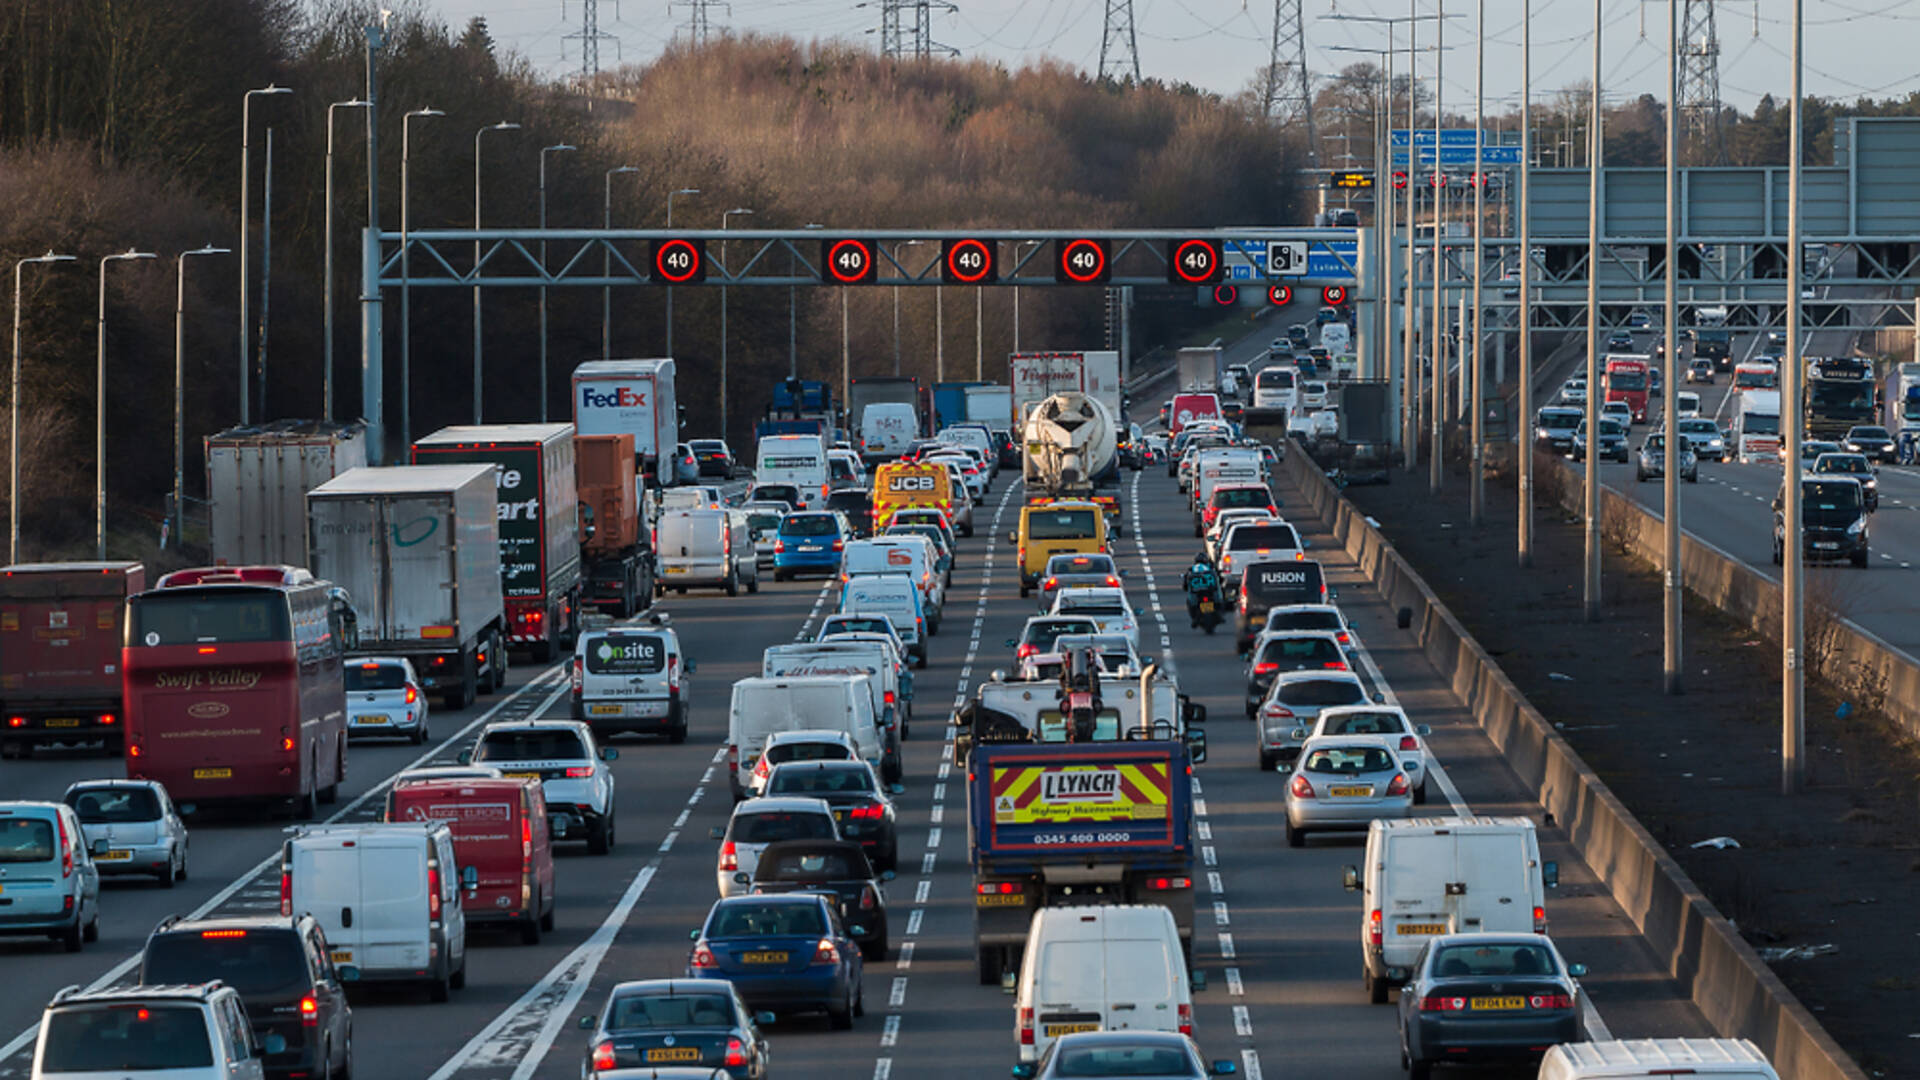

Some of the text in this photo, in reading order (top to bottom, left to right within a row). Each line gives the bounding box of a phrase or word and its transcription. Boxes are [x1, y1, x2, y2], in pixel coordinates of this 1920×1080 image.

[667, 253, 689, 268] 40
[839, 253, 861, 268] 40
[960, 253, 981, 268] 40
[1073, 253, 1095, 268] 40
[1185, 253, 1207, 268] 40
[583, 387, 646, 407] FedEx
[496, 464, 521, 488] ie
[890, 477, 934, 490] JCB
[496, 498, 539, 520] art
[1262, 571, 1305, 583] FUSION
[156, 669, 262, 690] Swift Valley
[1031, 805, 1131, 816] Highway Maintenance
[1034, 832, 1130, 844] 0345 400 0000
